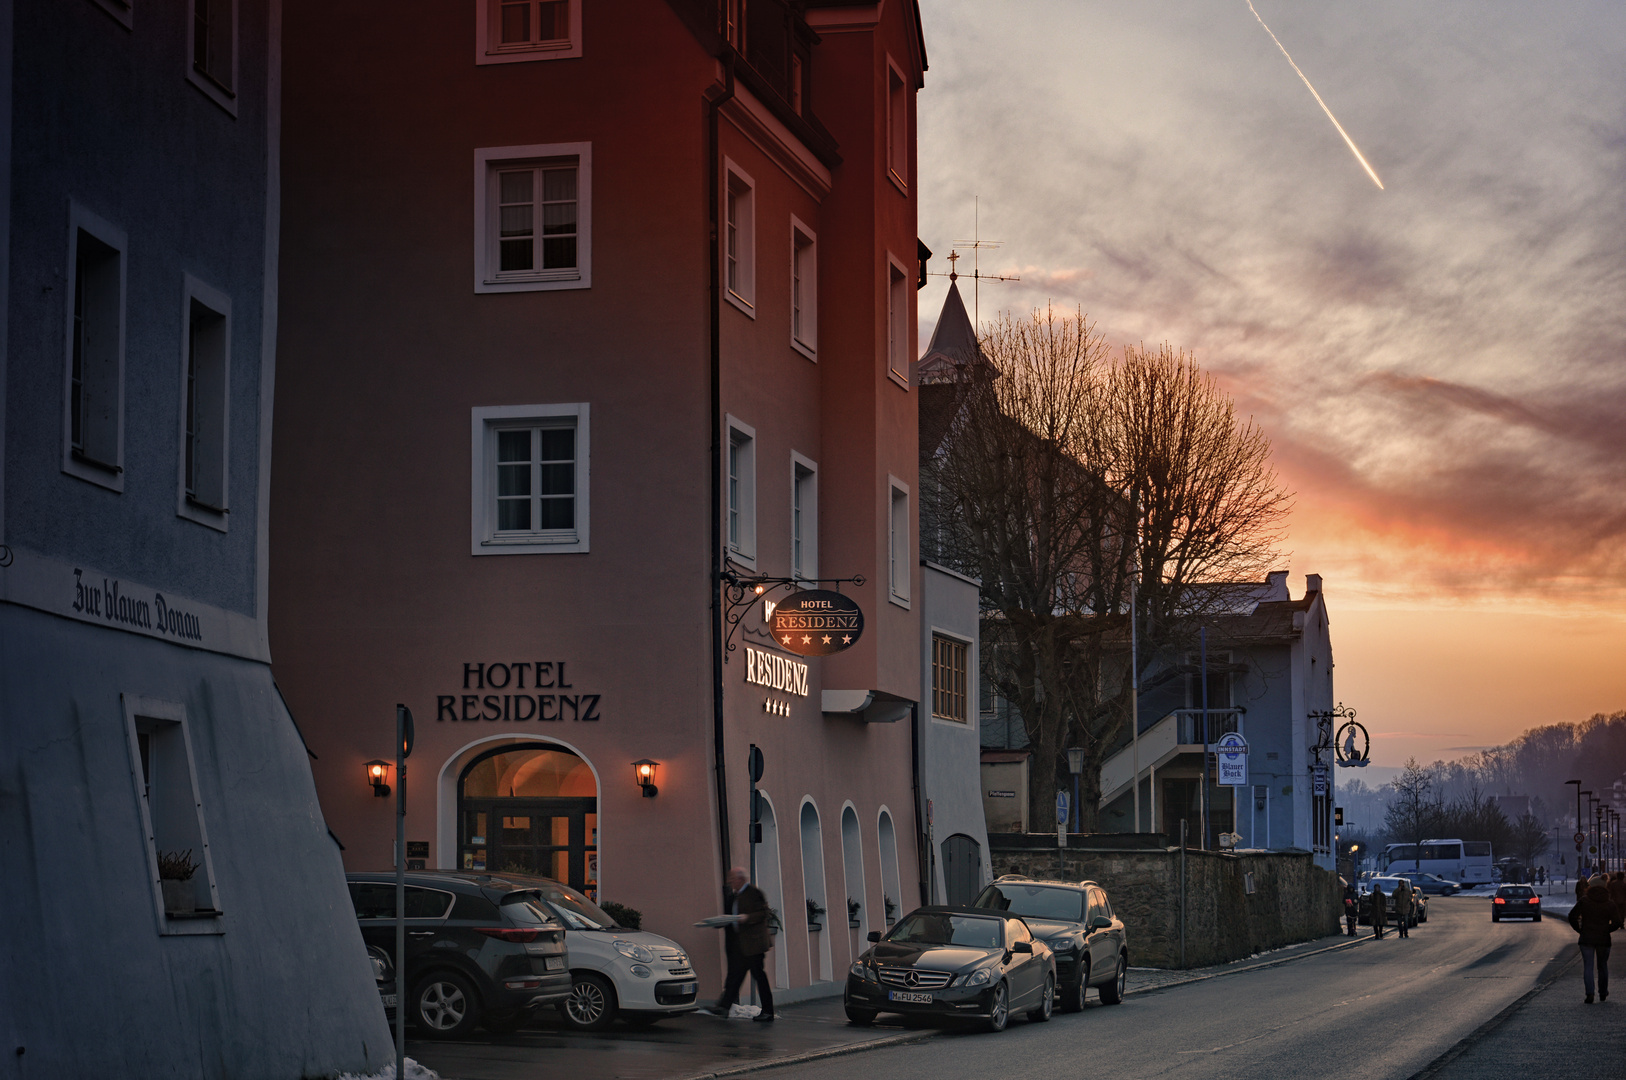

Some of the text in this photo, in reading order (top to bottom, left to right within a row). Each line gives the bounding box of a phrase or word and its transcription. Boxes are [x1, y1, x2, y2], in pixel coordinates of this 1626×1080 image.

[72, 568, 202, 641] Zur blauen Donau
[801, 600, 833, 609] HOTEL
[776, 616, 858, 628] RESIDENZ
[462, 661, 573, 689] HOTEL
[746, 647, 808, 697] RESIDENZ
[436, 694, 602, 722] RESIDENZ
[1223, 769, 1242, 778] Bock
[912, 994, 932, 1003] 2546
